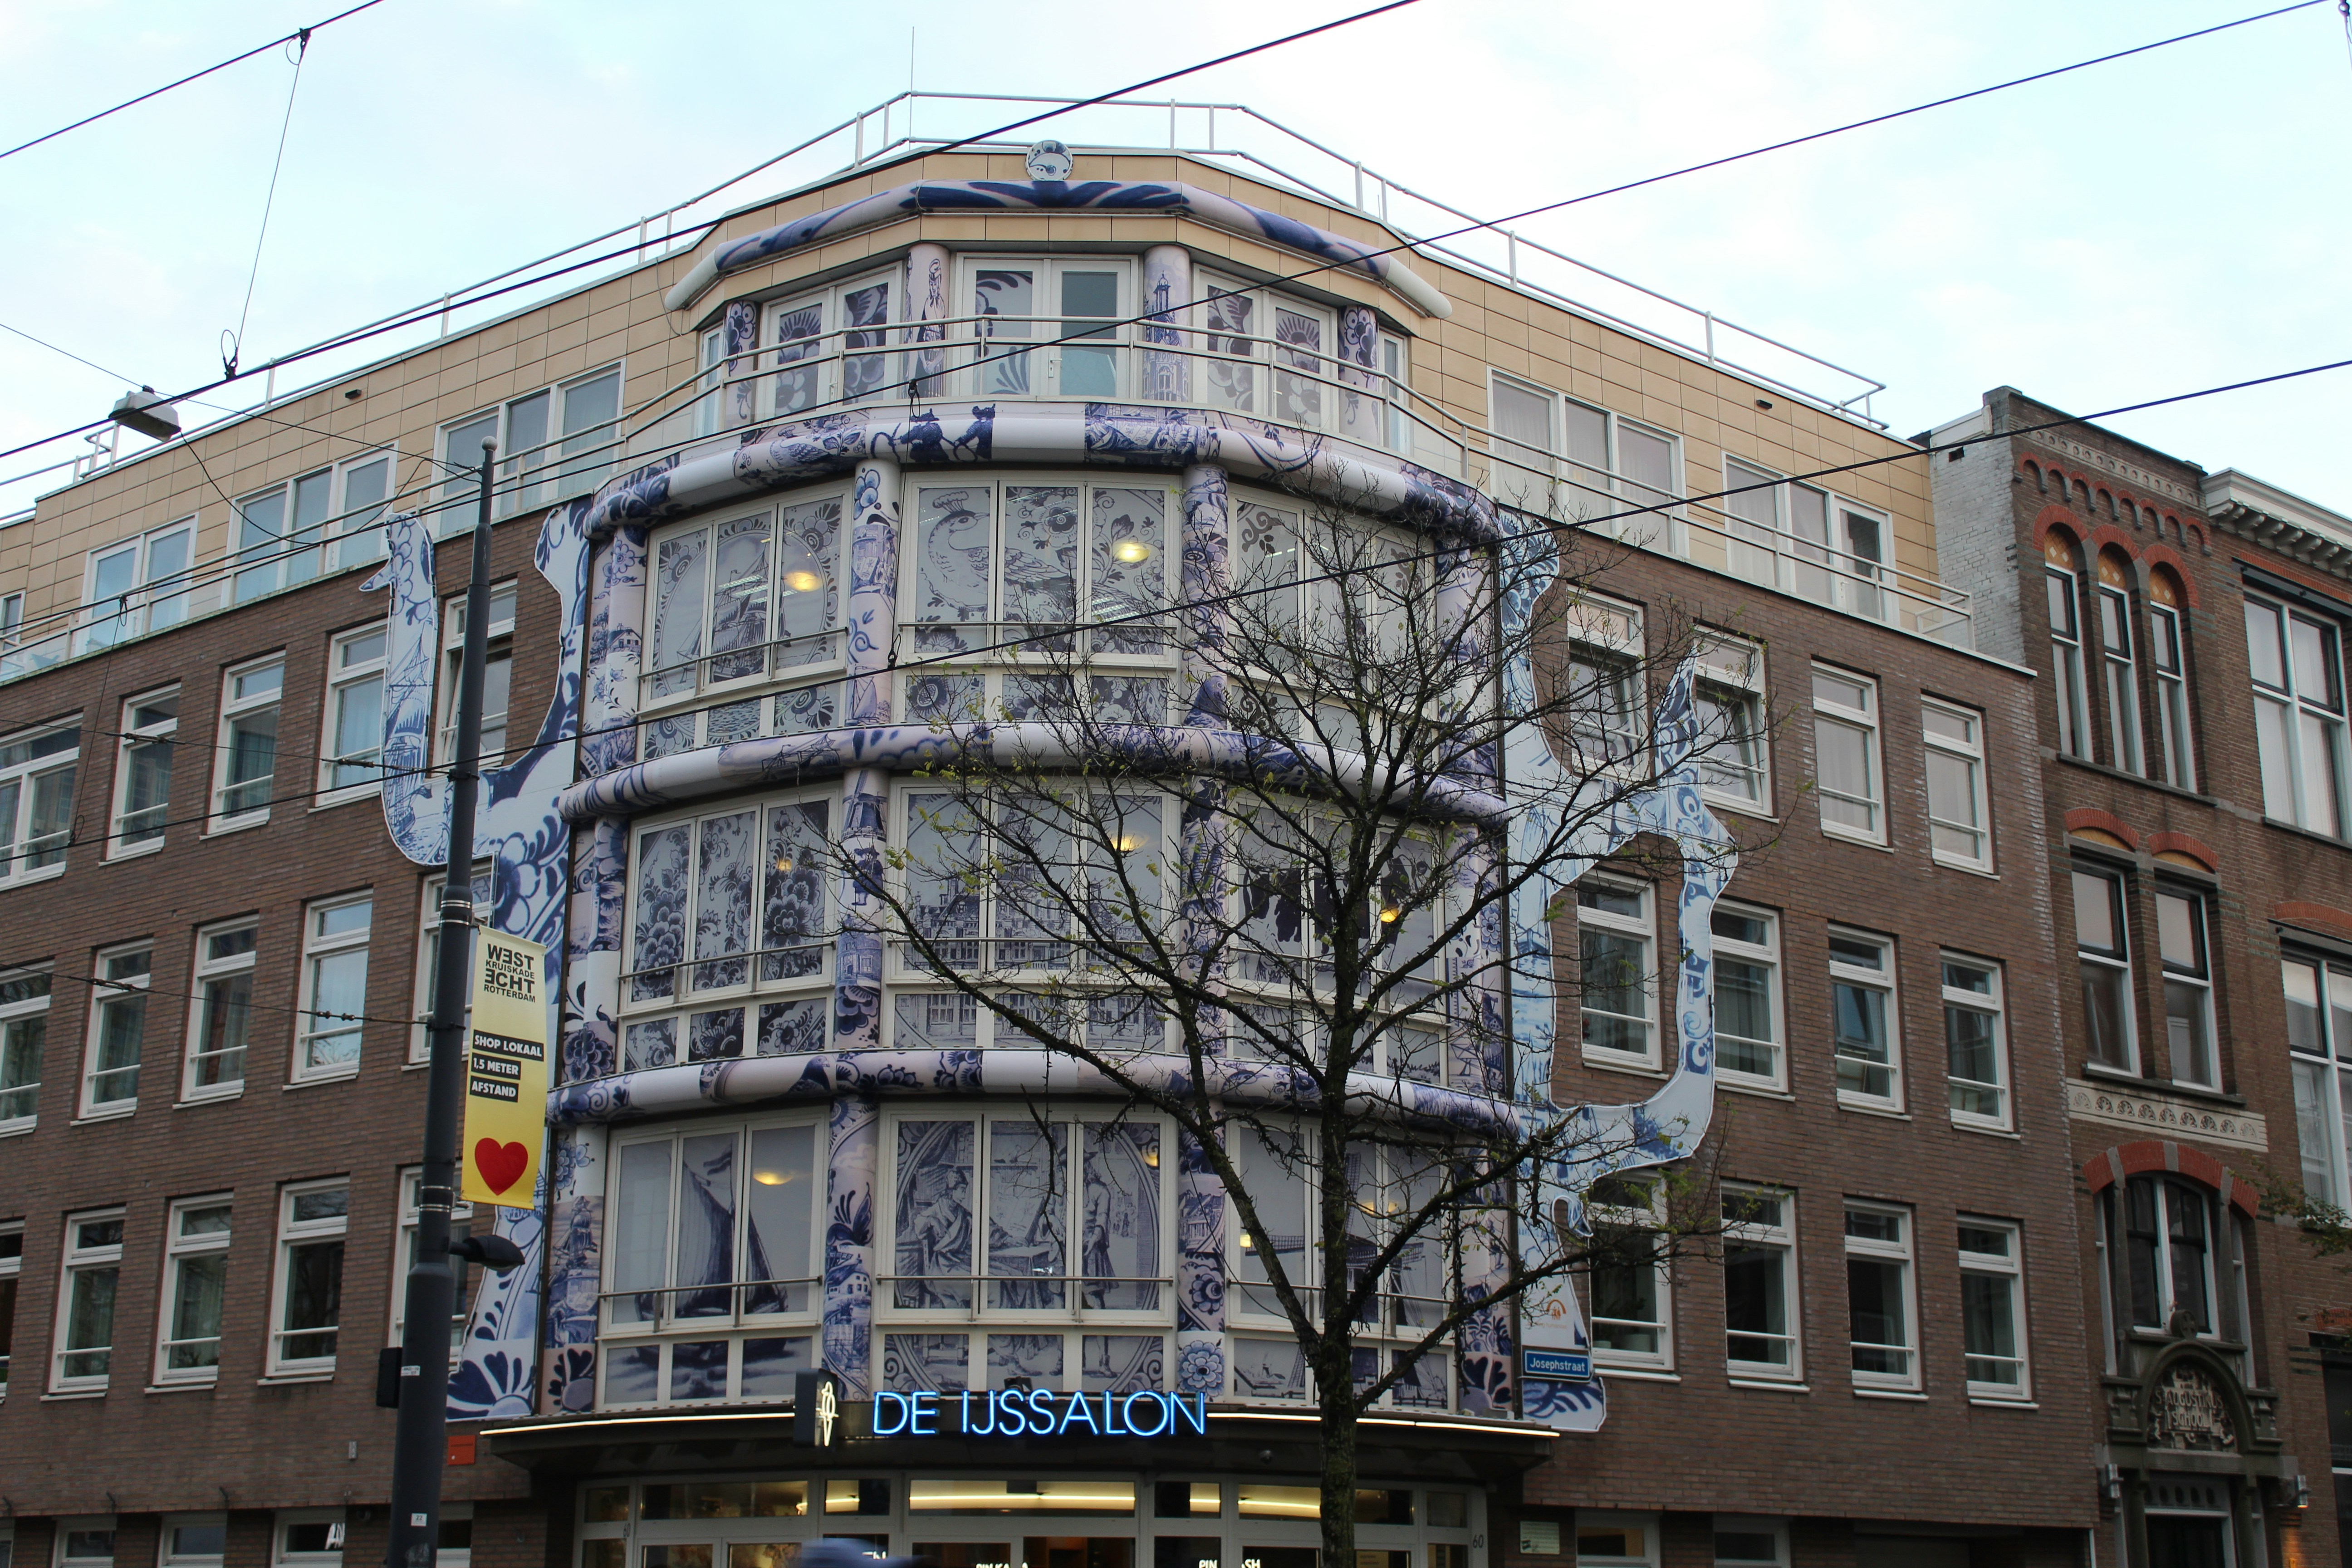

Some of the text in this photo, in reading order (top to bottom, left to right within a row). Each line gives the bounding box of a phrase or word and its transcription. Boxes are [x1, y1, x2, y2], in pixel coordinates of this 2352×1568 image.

[486, 959, 534, 979] KRUISKADE
[484, 984, 535, 1002] ROTTERDAM
[475, 1034, 542, 1057] SHOP LOKAAL
[473, 1058, 519, 1075] 1,5 METER
[471, 1081, 516, 1097] AFSTAND
[1530, 1357, 1585, 1372] Josephstraat
[2166, 1390, 2223, 1409] AUGUSTINUS
[873, 1389, 1205, 1437] DE IJSSALON
[2172, 1412, 2210, 1428] SCHOOL
[1472, 1534, 1484, 1548] 60
